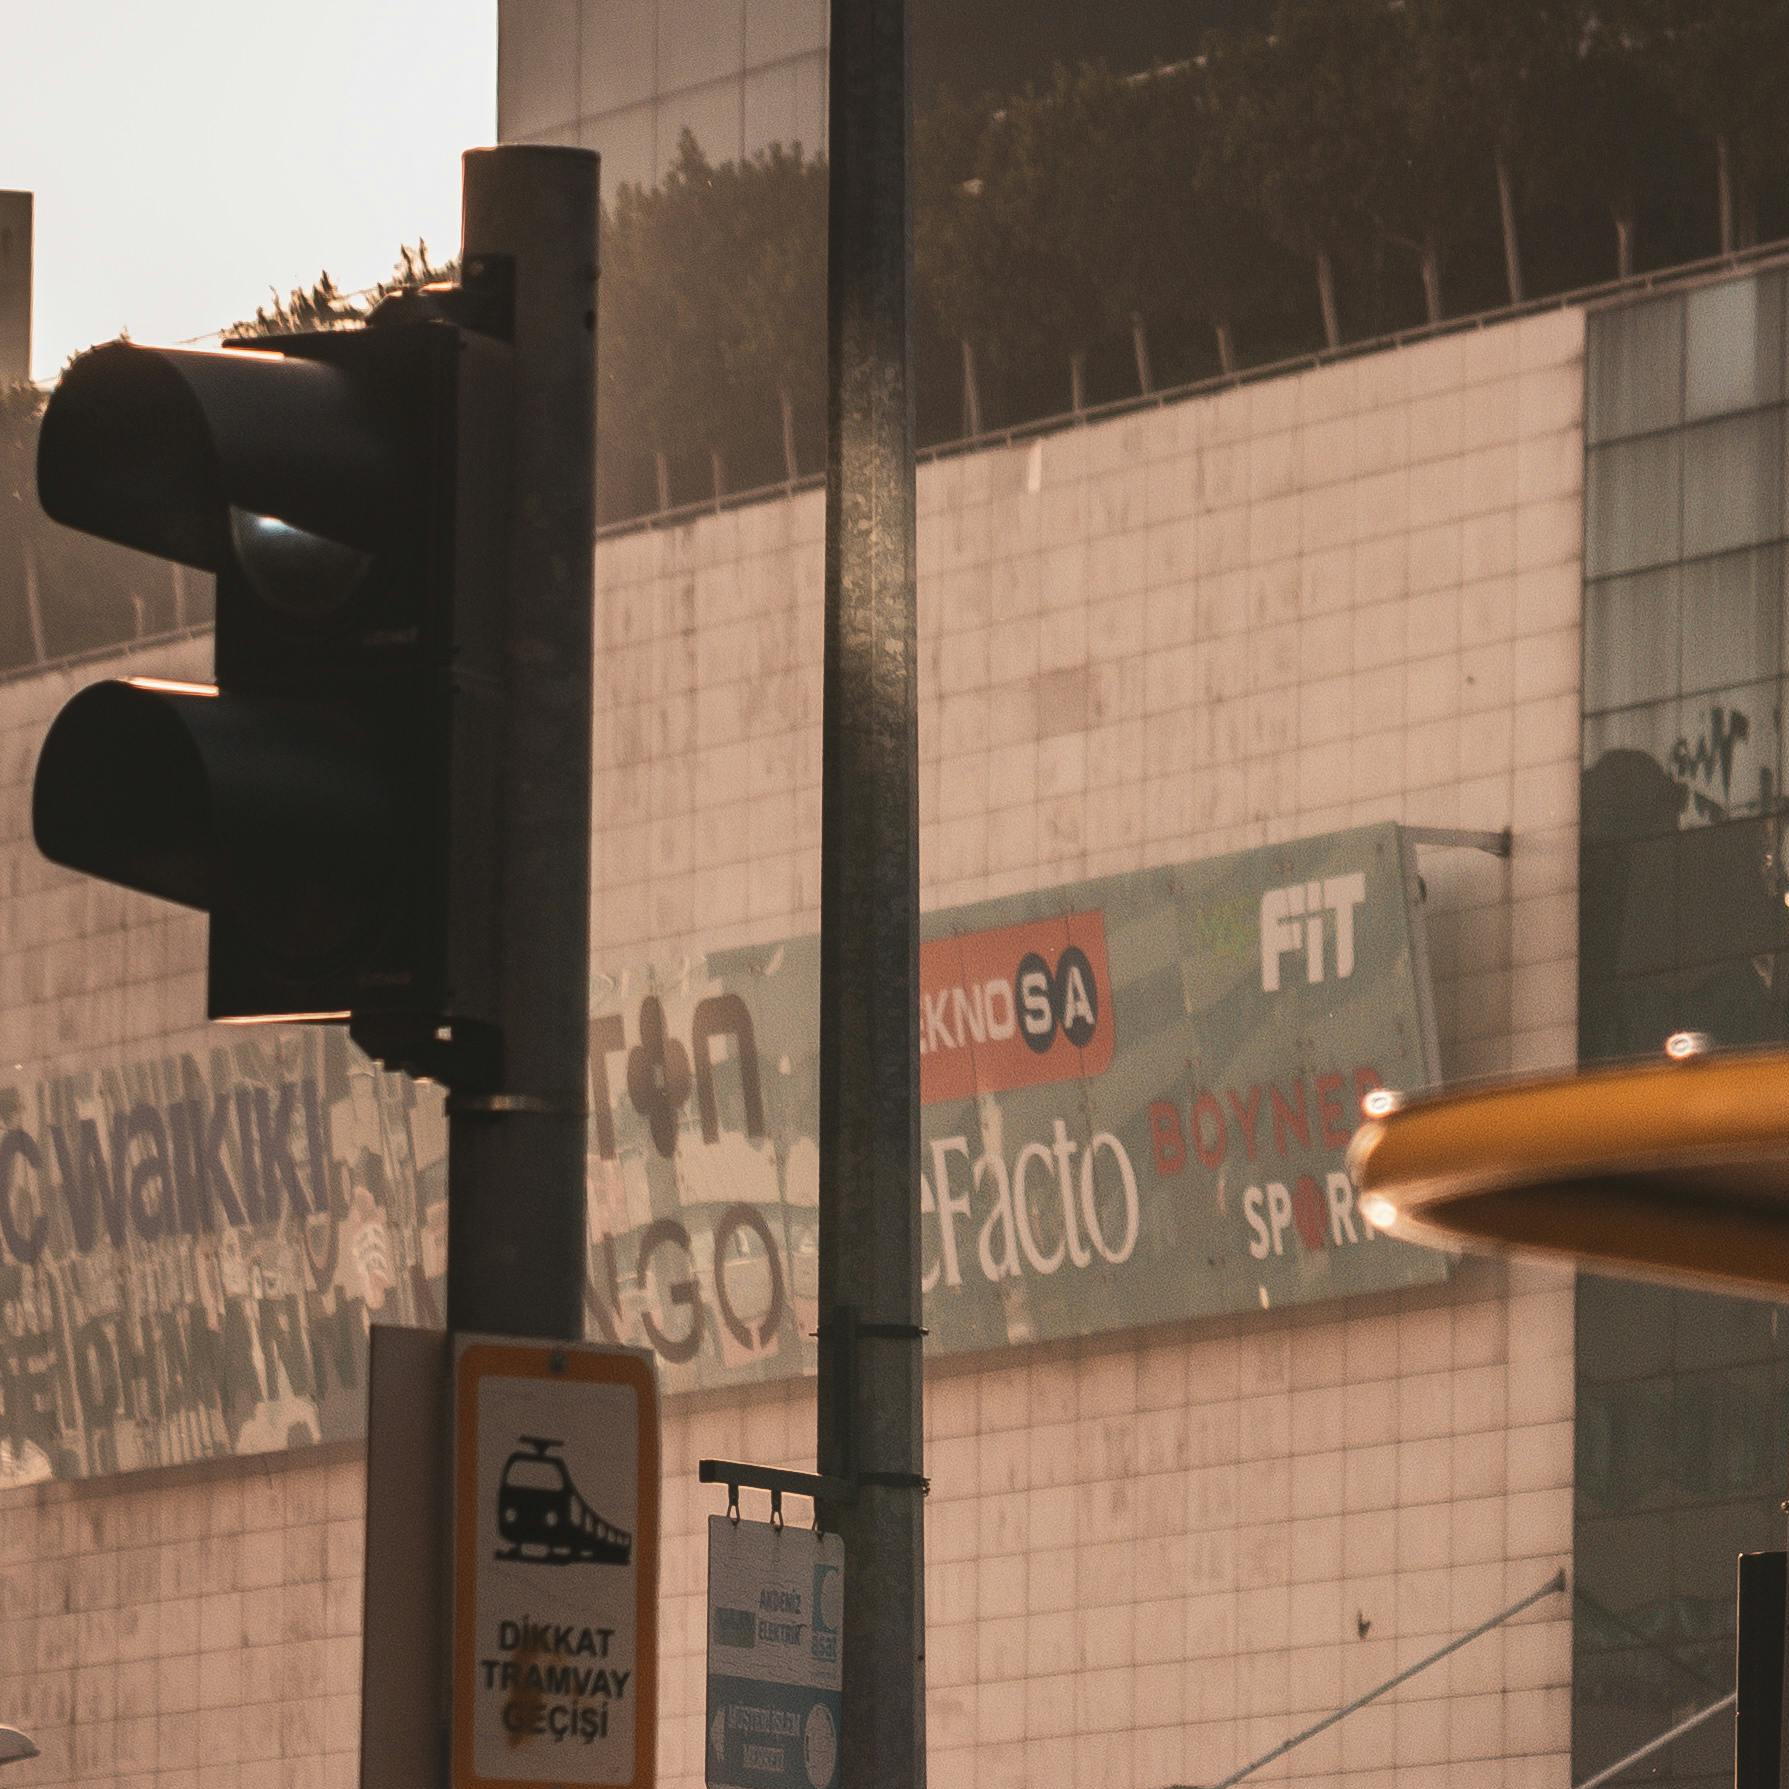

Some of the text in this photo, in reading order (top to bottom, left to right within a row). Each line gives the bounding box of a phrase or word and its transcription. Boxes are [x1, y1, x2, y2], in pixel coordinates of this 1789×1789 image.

[920, 965, 1097, 1056] KNOSA
[1242, 1168, 1377, 1260] SPOR
[498, 1614, 615, 1654] DİKKAT
[480, 1657, 632, 1700] TRAMVAY
